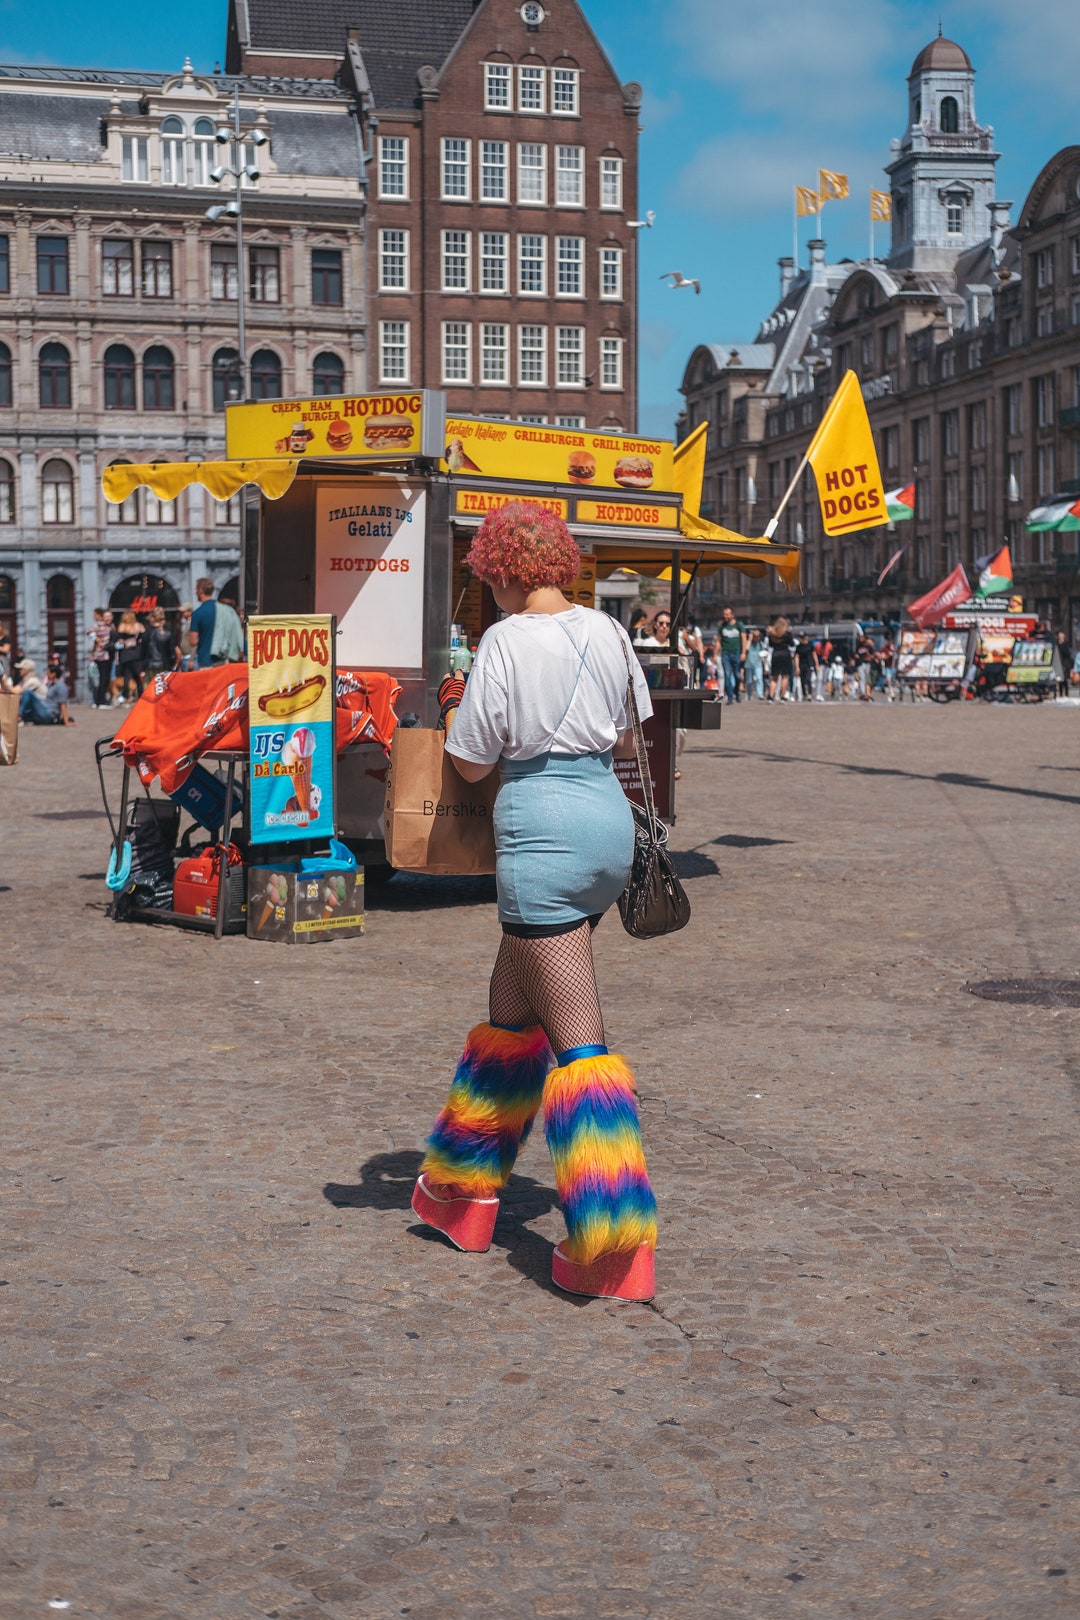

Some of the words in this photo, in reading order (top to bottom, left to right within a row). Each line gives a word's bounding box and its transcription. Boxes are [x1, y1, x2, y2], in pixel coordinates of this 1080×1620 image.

[271, 402, 302, 414] CREPS
[310, 401, 332, 411] HAM
[343, 396, 421, 417] HOTDOG
[302, 411, 340, 422] BURGER
[446, 420, 474, 439] Gelato
[474, 423, 507, 441] Italiano
[514, 430, 585, 447] GRILLBURGER
[593, 438, 622, 451] GRILL
[623, 441, 662, 455] HOTDOG
[825, 464, 868, 491] HOT
[823, 488, 880, 519] DOGS
[328, 505, 392, 522] ITALIAANS
[596, 505, 659, 523] HOTDOGS
[348, 521, 393, 537] Gelati
[330, 557, 410, 573] HOTDOGS
[252, 628, 285, 669] HOT
[288, 629, 329, 665] DOGS
[254, 732, 285, 758] IJS
[273, 761, 306, 776] Carlo
[423, 800, 487, 817] Bershka
